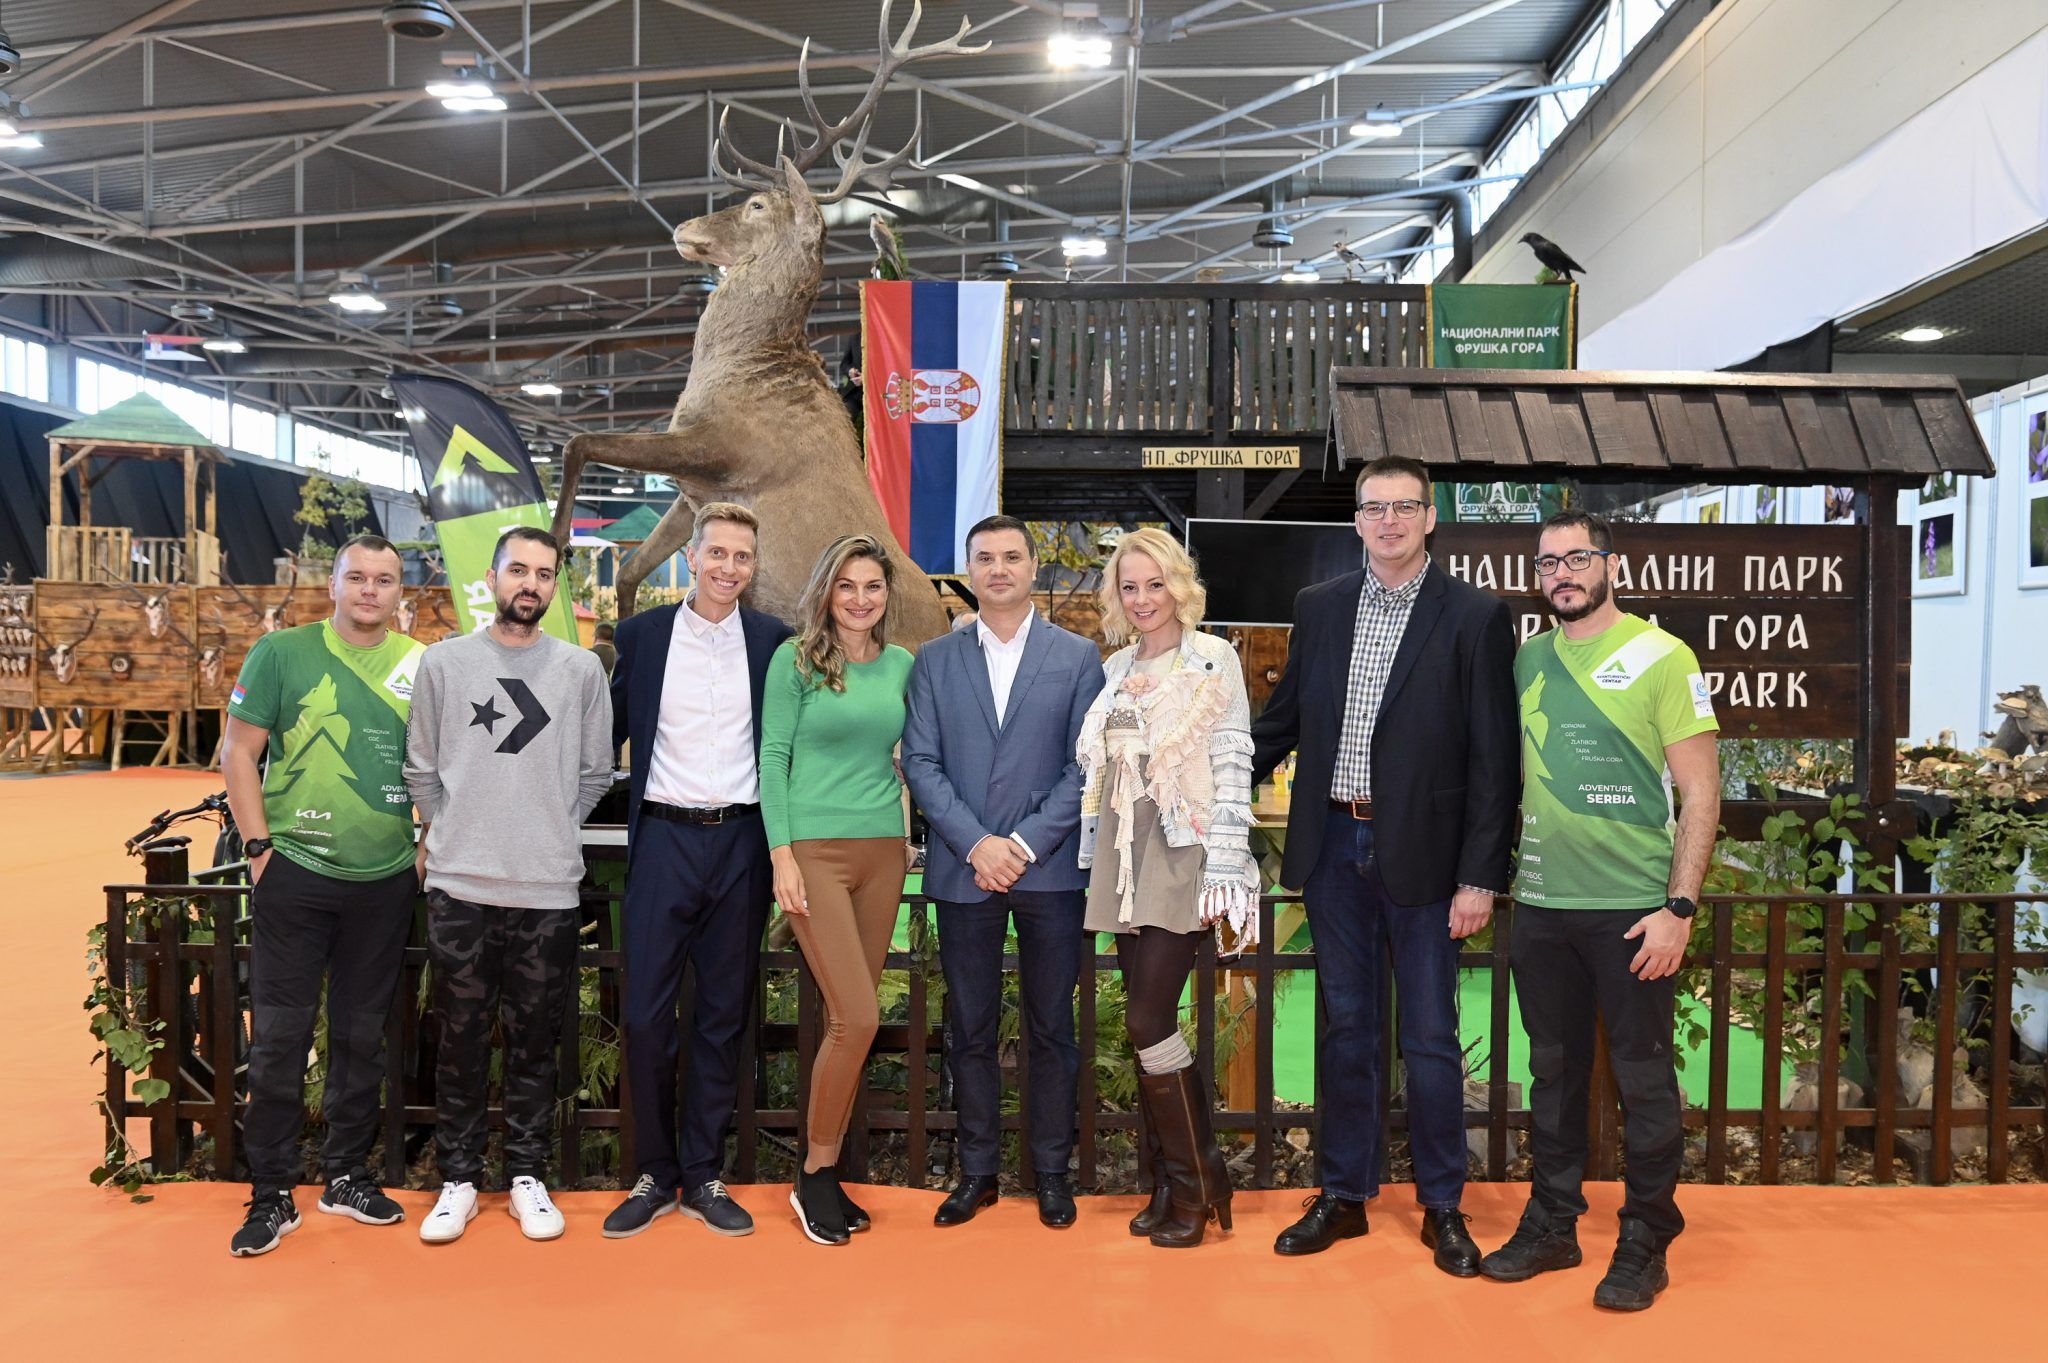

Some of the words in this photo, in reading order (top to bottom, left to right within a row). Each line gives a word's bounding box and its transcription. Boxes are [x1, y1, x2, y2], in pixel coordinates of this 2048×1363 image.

[1441, 326, 1525, 340] НАЦИОНАЛНИ
[1526, 326, 1560, 338] ПАРК
[1455, 343, 1509, 354] ФРУШКА
[1511, 342, 1545, 354] ГОРА
[1509, 504, 1535, 512] ГОРА
[1449, 554, 1715, 592] НАЦАЛНИ
[1744, 555, 1843, 593] ПАРК
[1708, 613, 1809, 651] ГОРА
[1704, 671, 1808, 708] PARK
[1578, 784, 1633, 792] ADVENTURE
[1586, 794, 1637, 804] SERBIA
